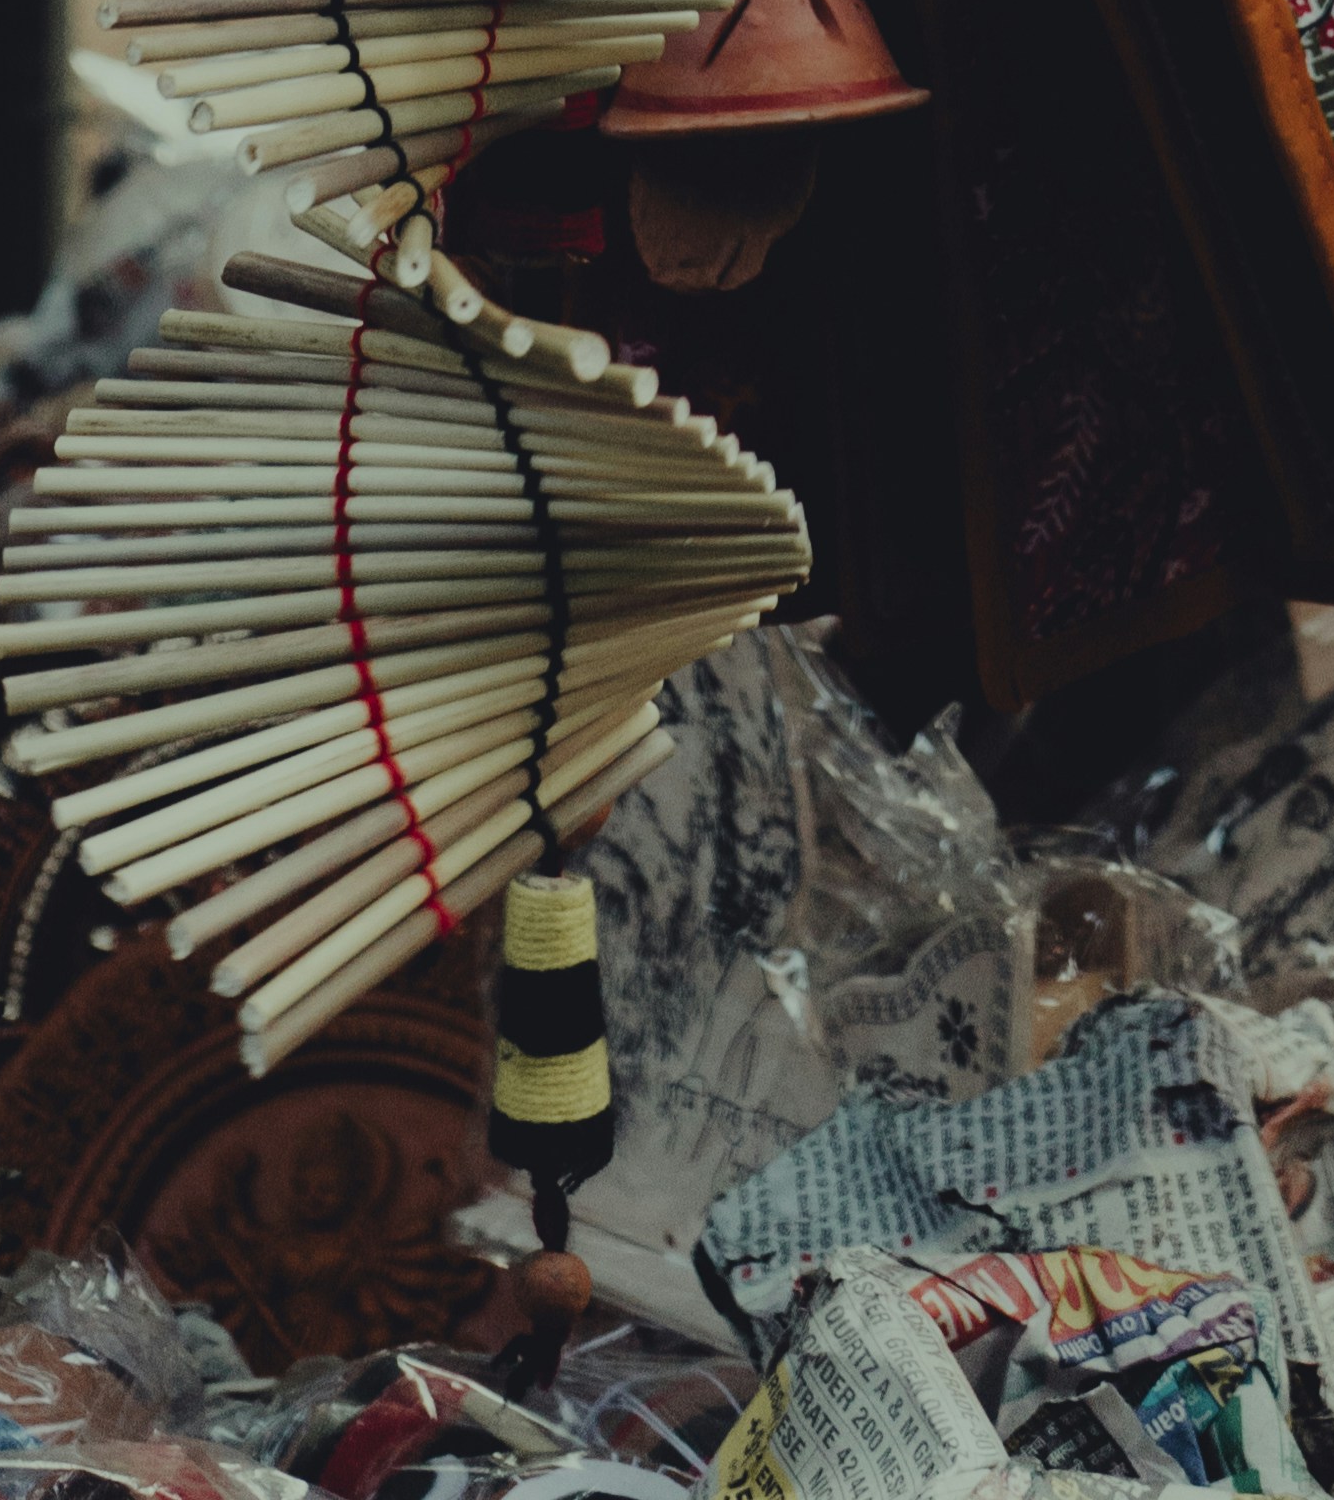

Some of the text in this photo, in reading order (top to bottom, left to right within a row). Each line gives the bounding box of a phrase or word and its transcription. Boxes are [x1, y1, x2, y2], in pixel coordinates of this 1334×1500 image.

[871, 1377, 898, 1404] A
[883, 1396, 911, 1423] &
[847, 1405, 889, 1453] 200
[893, 1414, 925, 1447] M
